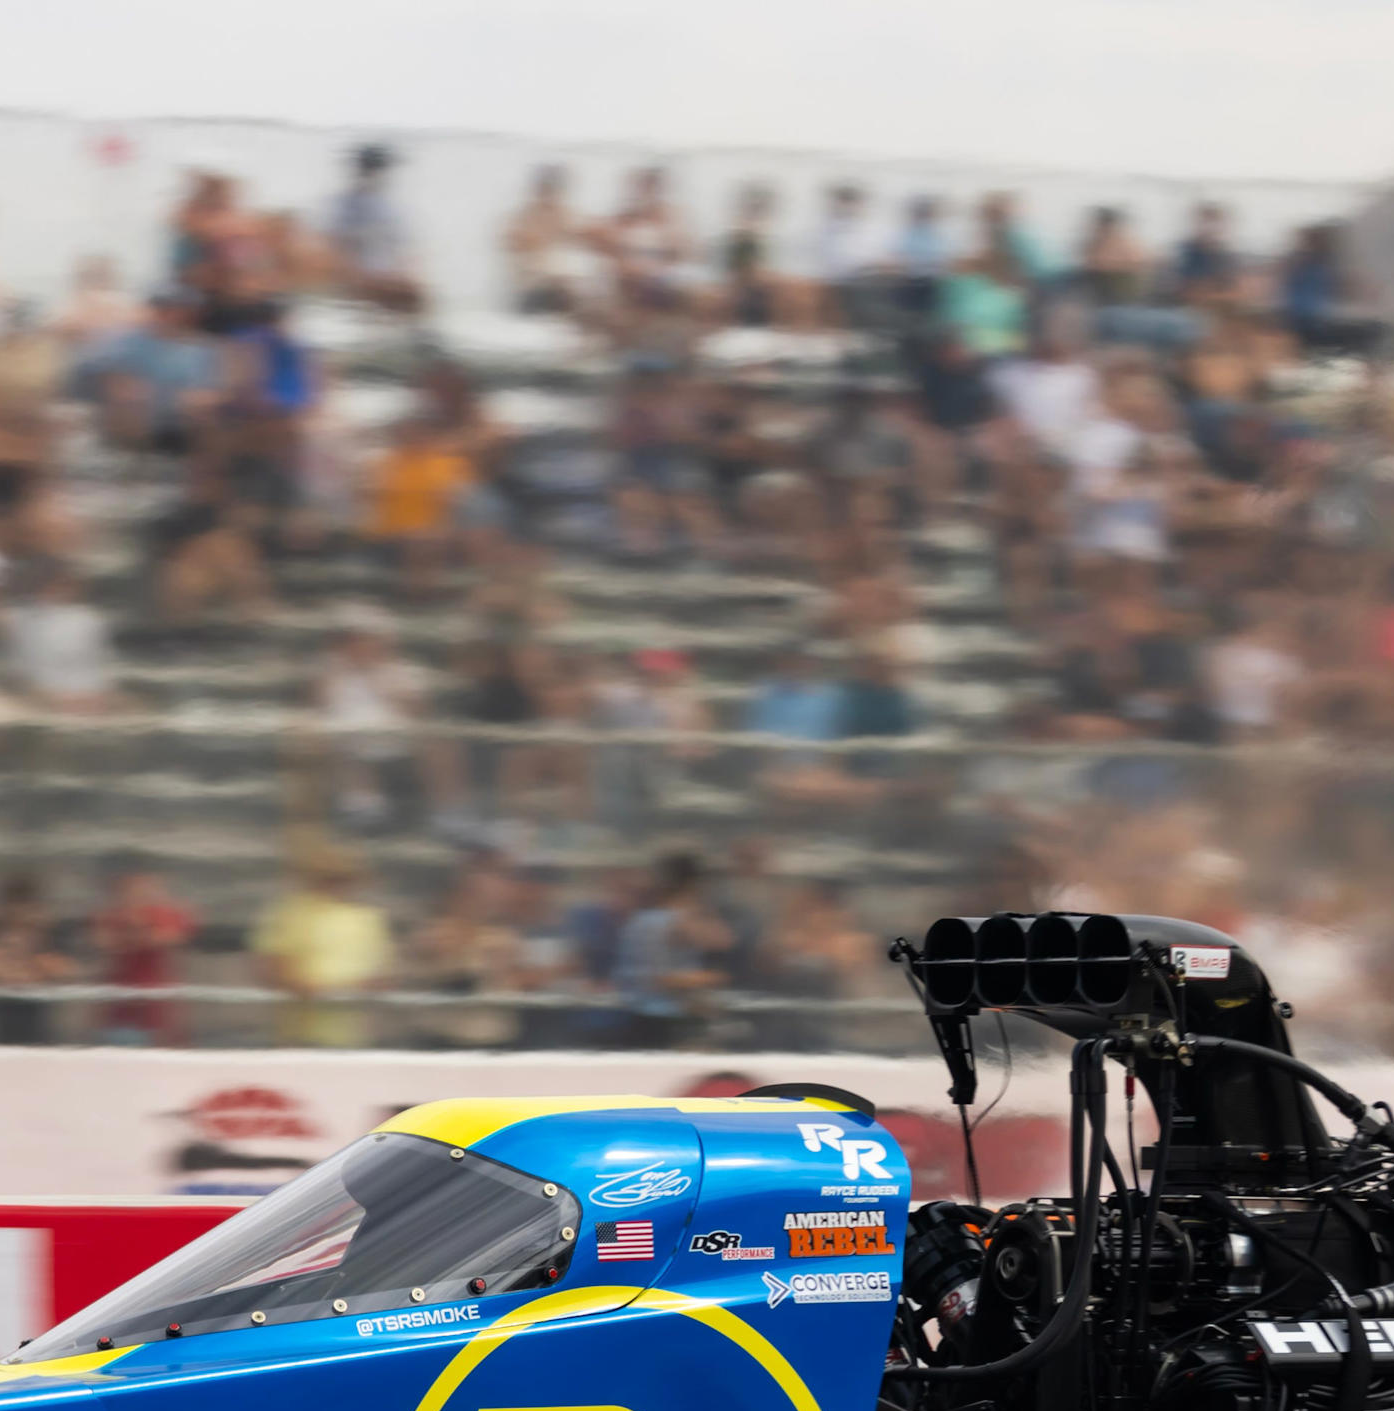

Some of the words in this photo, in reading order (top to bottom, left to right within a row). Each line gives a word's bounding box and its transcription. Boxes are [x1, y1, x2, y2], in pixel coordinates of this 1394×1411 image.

[784, 1211, 885, 1230] AMERICAN
[691, 1231, 740, 1253] DSR
[789, 1227, 896, 1257] REBEL
[722, 1248, 774, 1259] PERFORMANCE
[792, 1274, 889, 1292] CONVERGE
[356, 1304, 481, 1337] @TSRSMOKE
